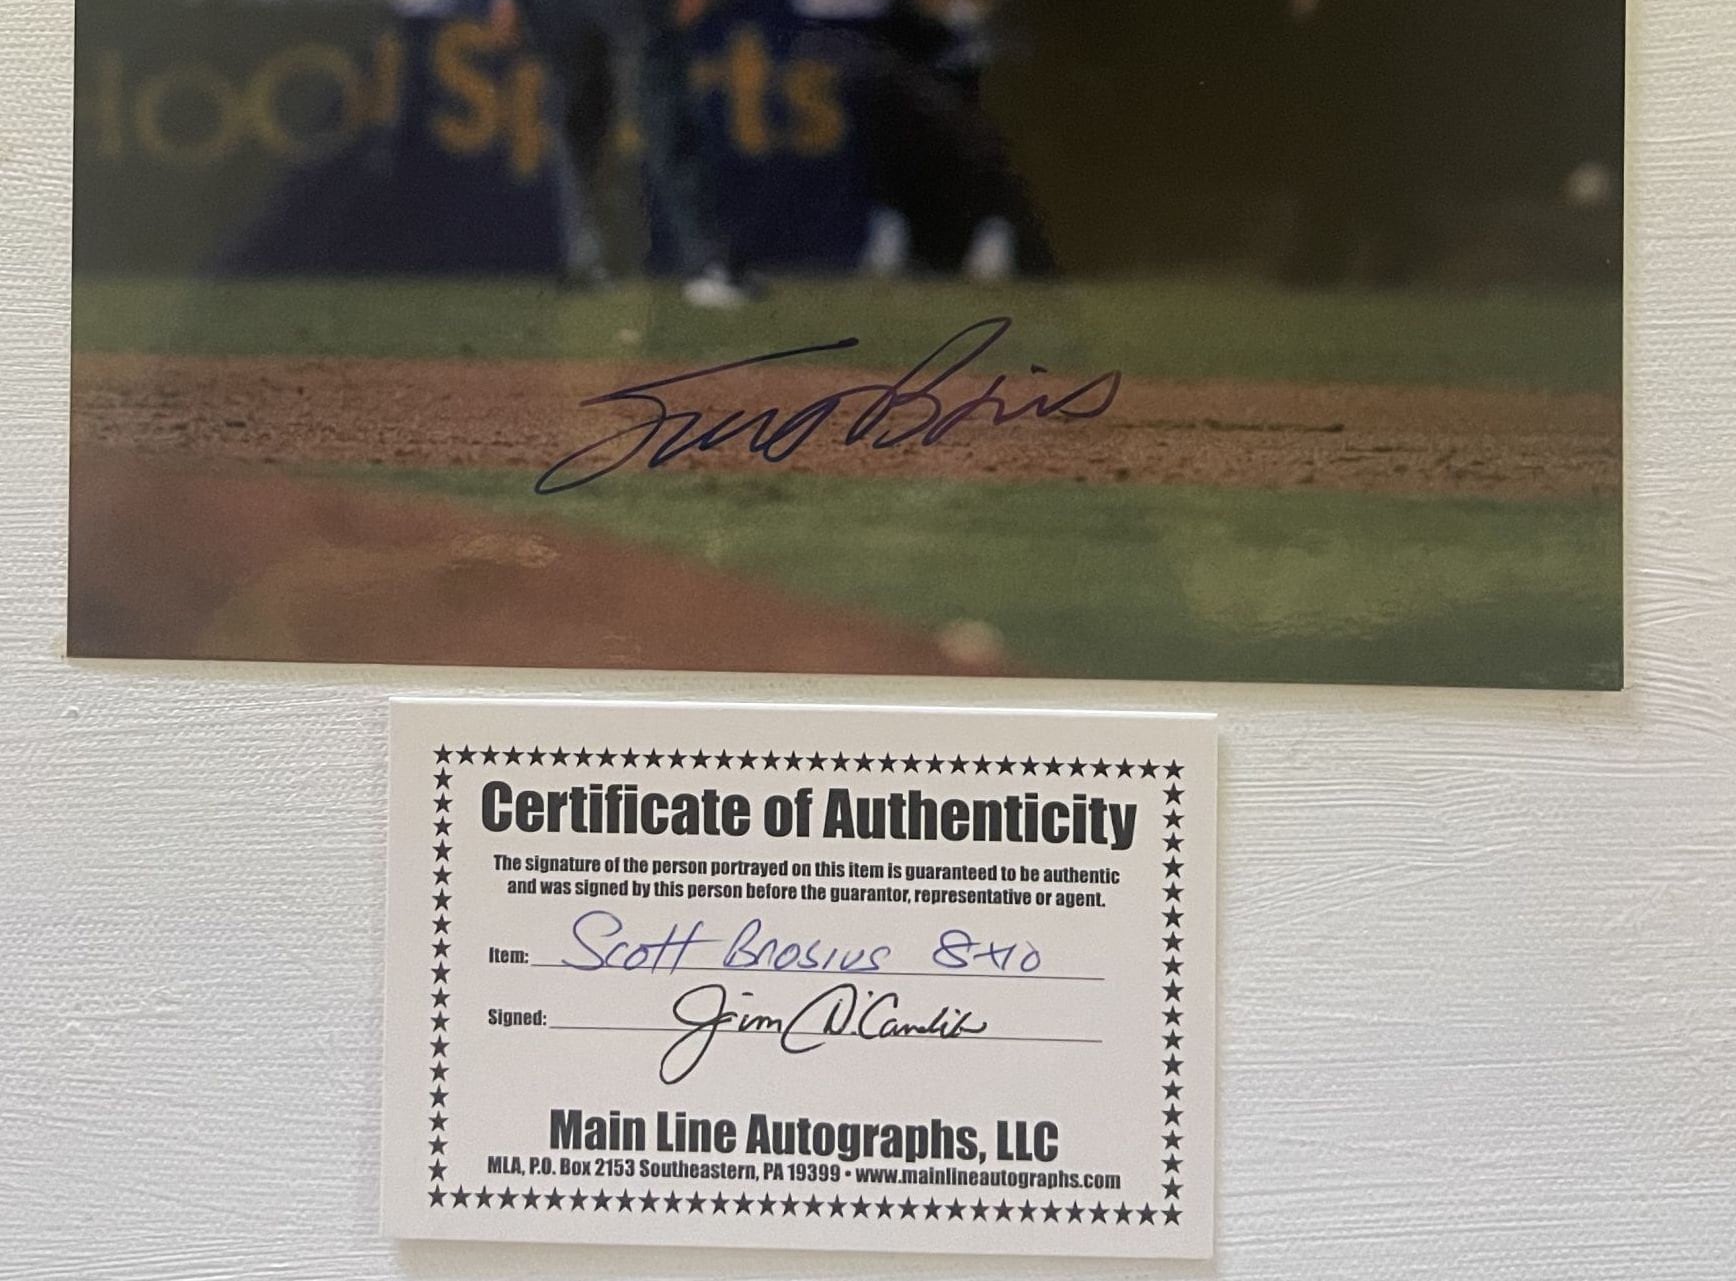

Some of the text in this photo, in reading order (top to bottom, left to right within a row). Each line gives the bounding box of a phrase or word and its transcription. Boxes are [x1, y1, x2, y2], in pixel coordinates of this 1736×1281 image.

[481, 780, 1138, 851] Certificate of Authenticity
[493, 854, 1120, 885] The signature of the person portrayed on this item is guaranteed to be authentic
[507, 878, 1106, 909] and was signed by this person before the guarantor, representative or agent.
[488, 947, 529, 964] Item:
[561, 910, 724, 974] Scott
[488, 1009, 547, 1027] Signed:
[550, 1109, 1059, 1165] Main Line Autographs, LLC
[487, 1155, 1121, 1190] MLA, P.O. Box 2153 Southeastern, PA 19399 www.mainlineautographs.com
